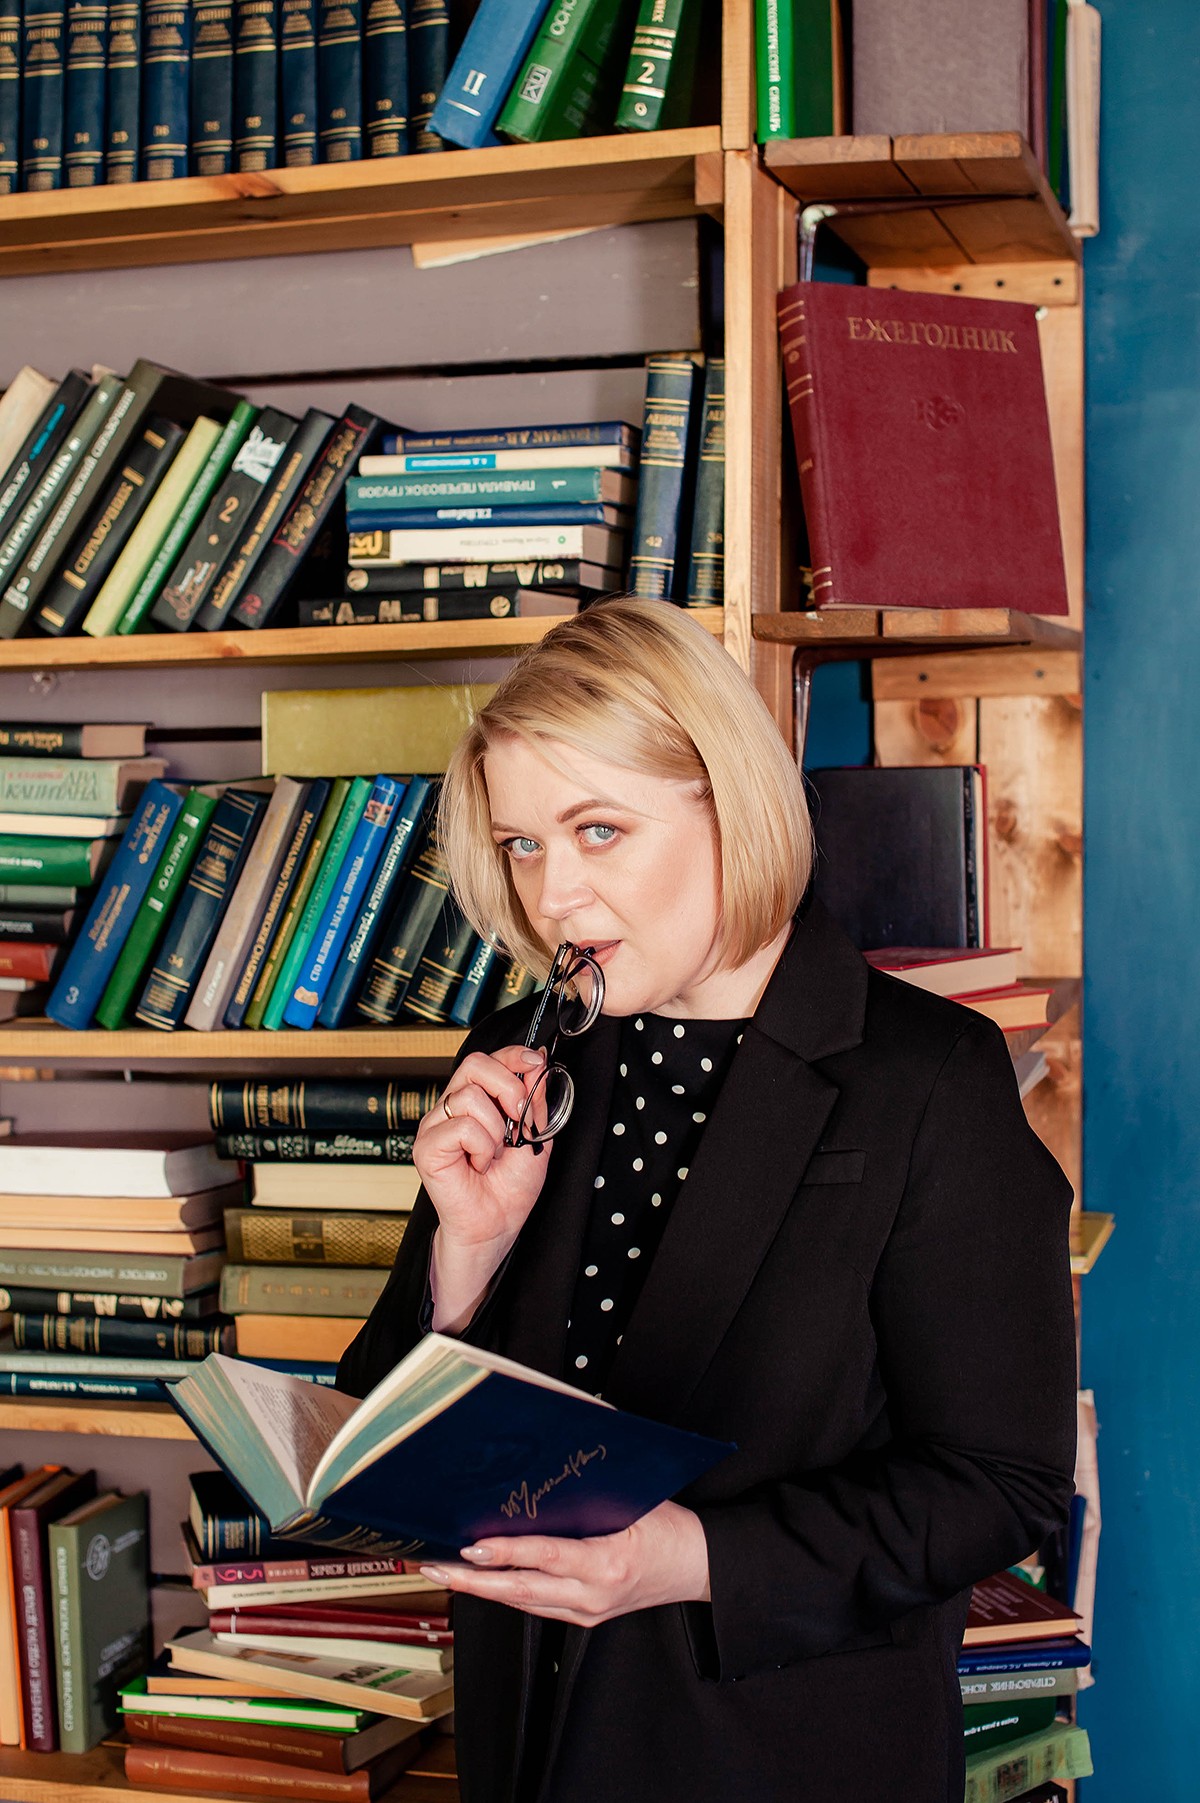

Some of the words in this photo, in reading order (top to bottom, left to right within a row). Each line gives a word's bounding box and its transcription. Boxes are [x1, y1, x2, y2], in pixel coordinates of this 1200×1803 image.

[637, 61, 656, 83] 2
[847, 316, 1019, 354] ЕЖЕГОДНИК
[358, 485, 403, 499] ГРУЗОВ
[405, 482, 476, 497] ПЕРЕВОЗОК
[477, 479, 535, 493] ПРАВИЛА
[219, 497, 239, 523] 2
[367, 816, 413, 911] Промышленные
[346, 910, 376, 964] тракторы
[66, 987, 79, 1004] 3
[309, 1562, 346, 1577] язык
[346, 1556, 404, 1578] Русский
[991, 1676, 1056, 1693] СПРАВОЧНИК
